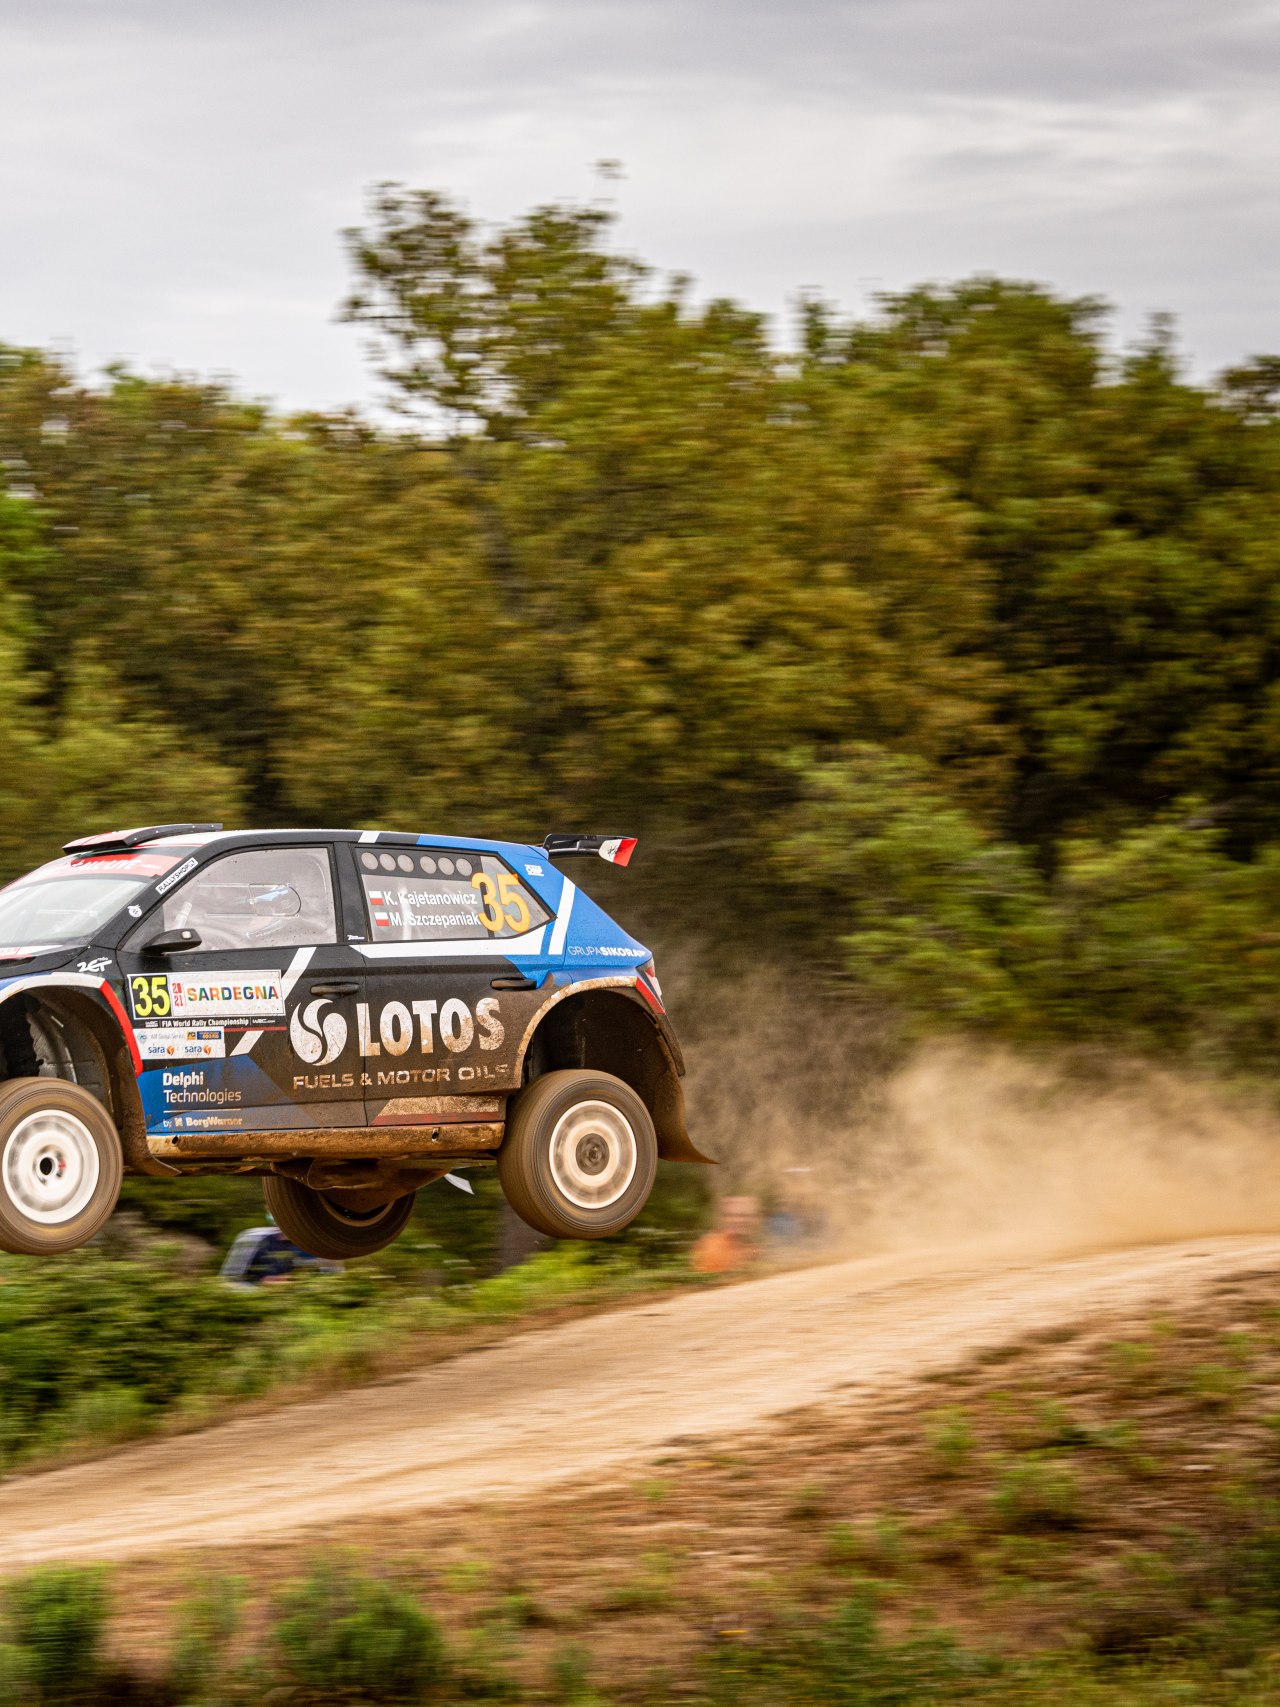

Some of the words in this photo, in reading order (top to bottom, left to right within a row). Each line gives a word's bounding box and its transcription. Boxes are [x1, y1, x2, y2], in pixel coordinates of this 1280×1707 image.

[384, 891, 397, 906] K.
[397, 890, 478, 907] Kajetanowicz
[471, 872, 531, 933] 35
[389, 912, 404, 927] M.
[409, 910, 482, 929] Szczepaniak
[132, 976, 170, 1017] 35
[174, 995, 184, 1007] 21
[186, 985, 279, 1002] SARDEGNA
[161, 1020, 173, 1028] FIA
[173, 1019, 191, 1028] World
[191, 1019, 207, 1028] Rally
[208, 1017, 249, 1028] Championship
[355, 997, 506, 1057] LOTOS
[148, 1045, 166, 1054] sara
[184, 1044, 203, 1053] sara
[162, 1071, 204, 1088] Delphi
[293, 1072, 354, 1090] FUELS
[359, 1072, 373, 1087] &
[377, 1068, 451, 1086] MOTOR
[458, 1064, 509, 1082] OILS
[163, 1088, 242, 1105] Technologies
[162, 1118, 173, 1129] by
[185, 1116, 243, 1128] BorgWarner
